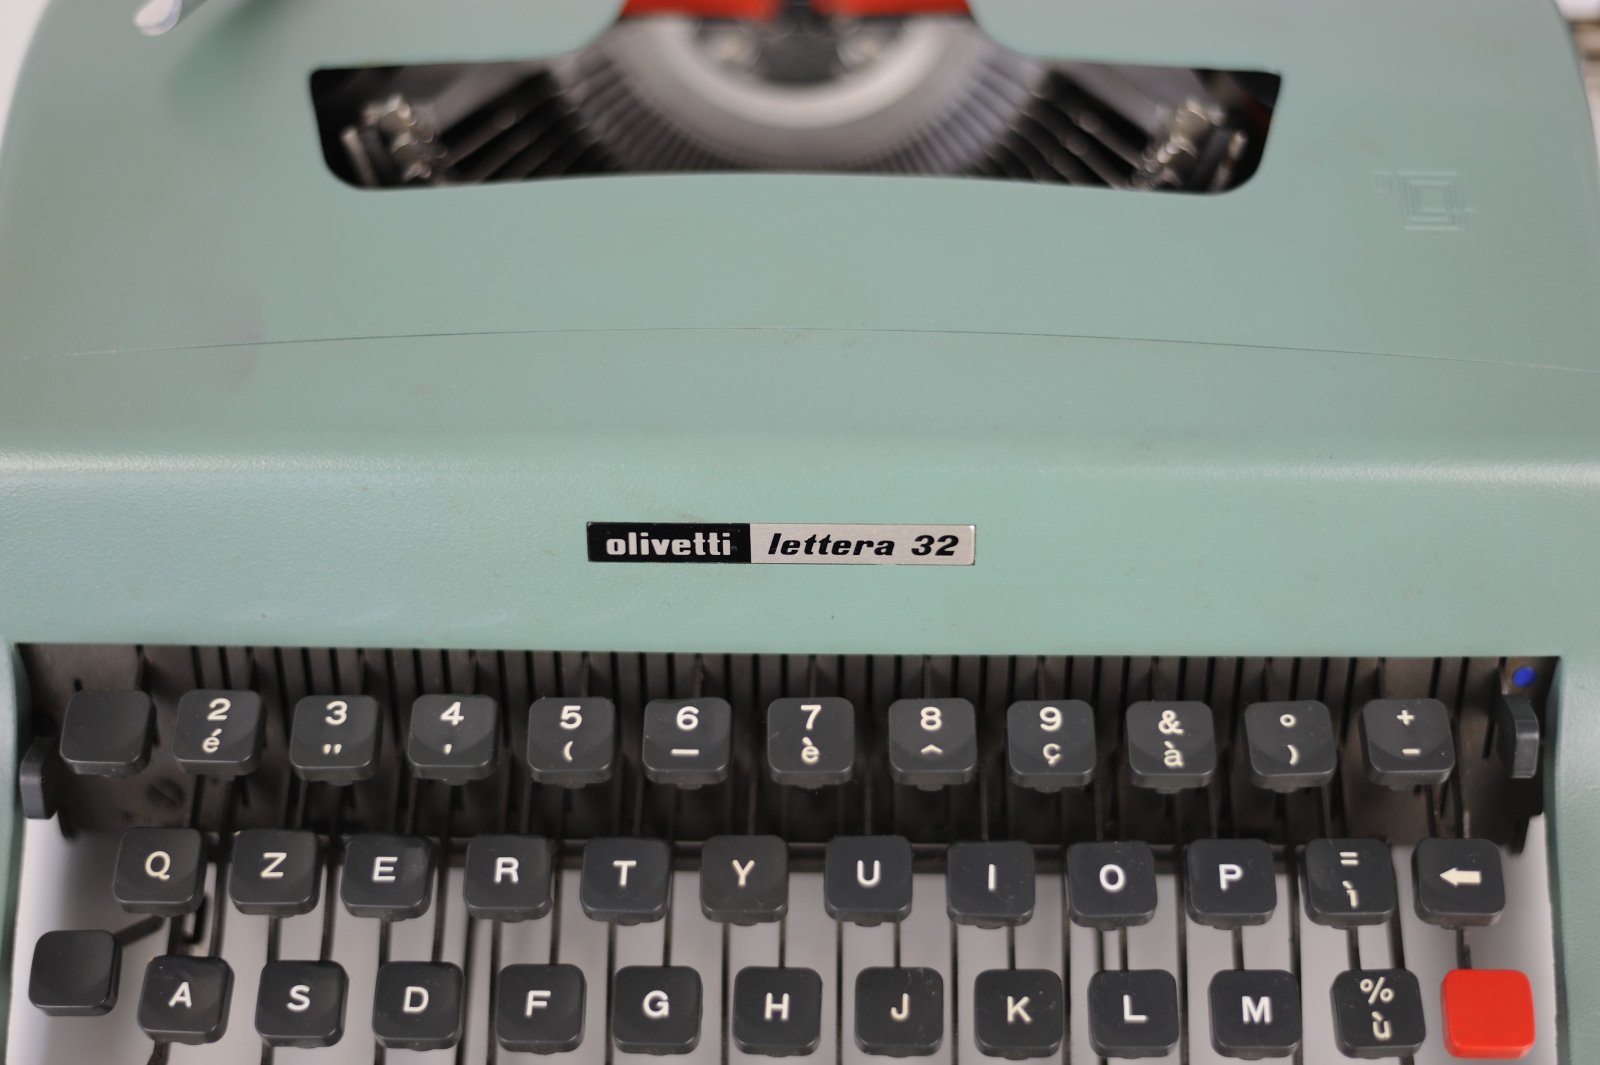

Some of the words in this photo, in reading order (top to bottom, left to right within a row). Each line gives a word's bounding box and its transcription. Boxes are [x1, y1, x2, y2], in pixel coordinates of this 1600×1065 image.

[606, 531, 732, 556] olivetti
[768, 533, 895, 557] lettera
[911, 534, 960, 557] 32
[206, 697, 232, 721] 2
[325, 700, 348, 726] 3
[439, 701, 465, 726] 4
[559, 705, 583, 730] 5
[674, 705, 700, 731] 6
[800, 704, 822, 731] 7
[920, 706, 943, 732] 8
[1039, 706, 1063, 732] 9
[1157, 709, 1185, 735] &
[1396, 709, 1415, 726] +
[202, 728, 223, 754] é
[563, 740, 574, 762] (
[800, 736, 820, 765] è
[1163, 740, 1184, 768] à
[1042, 744, 1061, 766] ç
[1287, 744, 1299, 766] )
[144, 850, 171, 881] Q
[260, 852, 288, 878] Z
[372, 856, 398, 882] E
[494, 856, 519, 884] R
[1339, 851, 1359, 866] =
[612, 860, 637, 887] T
[732, 859, 755, 887] Y
[856, 859, 881, 887] U
[987, 863, 996, 891] I
[1099, 863, 1126, 892] O
[1218, 863, 1243, 891] P
[168, 981, 192, 1008] A
[286, 984, 311, 1012] S
[403, 985, 429, 1013] D
[525, 990, 552, 1017] F
[642, 989, 670, 1019] G
[1359, 976, 1394, 1005] %
[764, 992, 790, 1021] H
[890, 992, 909, 1021] J
[1006, 995, 1032, 1023] K
[1122, 994, 1148, 1023] L
[1241, 995, 1272, 1024] M
[1371, 1011, 1393, 1040] ù
